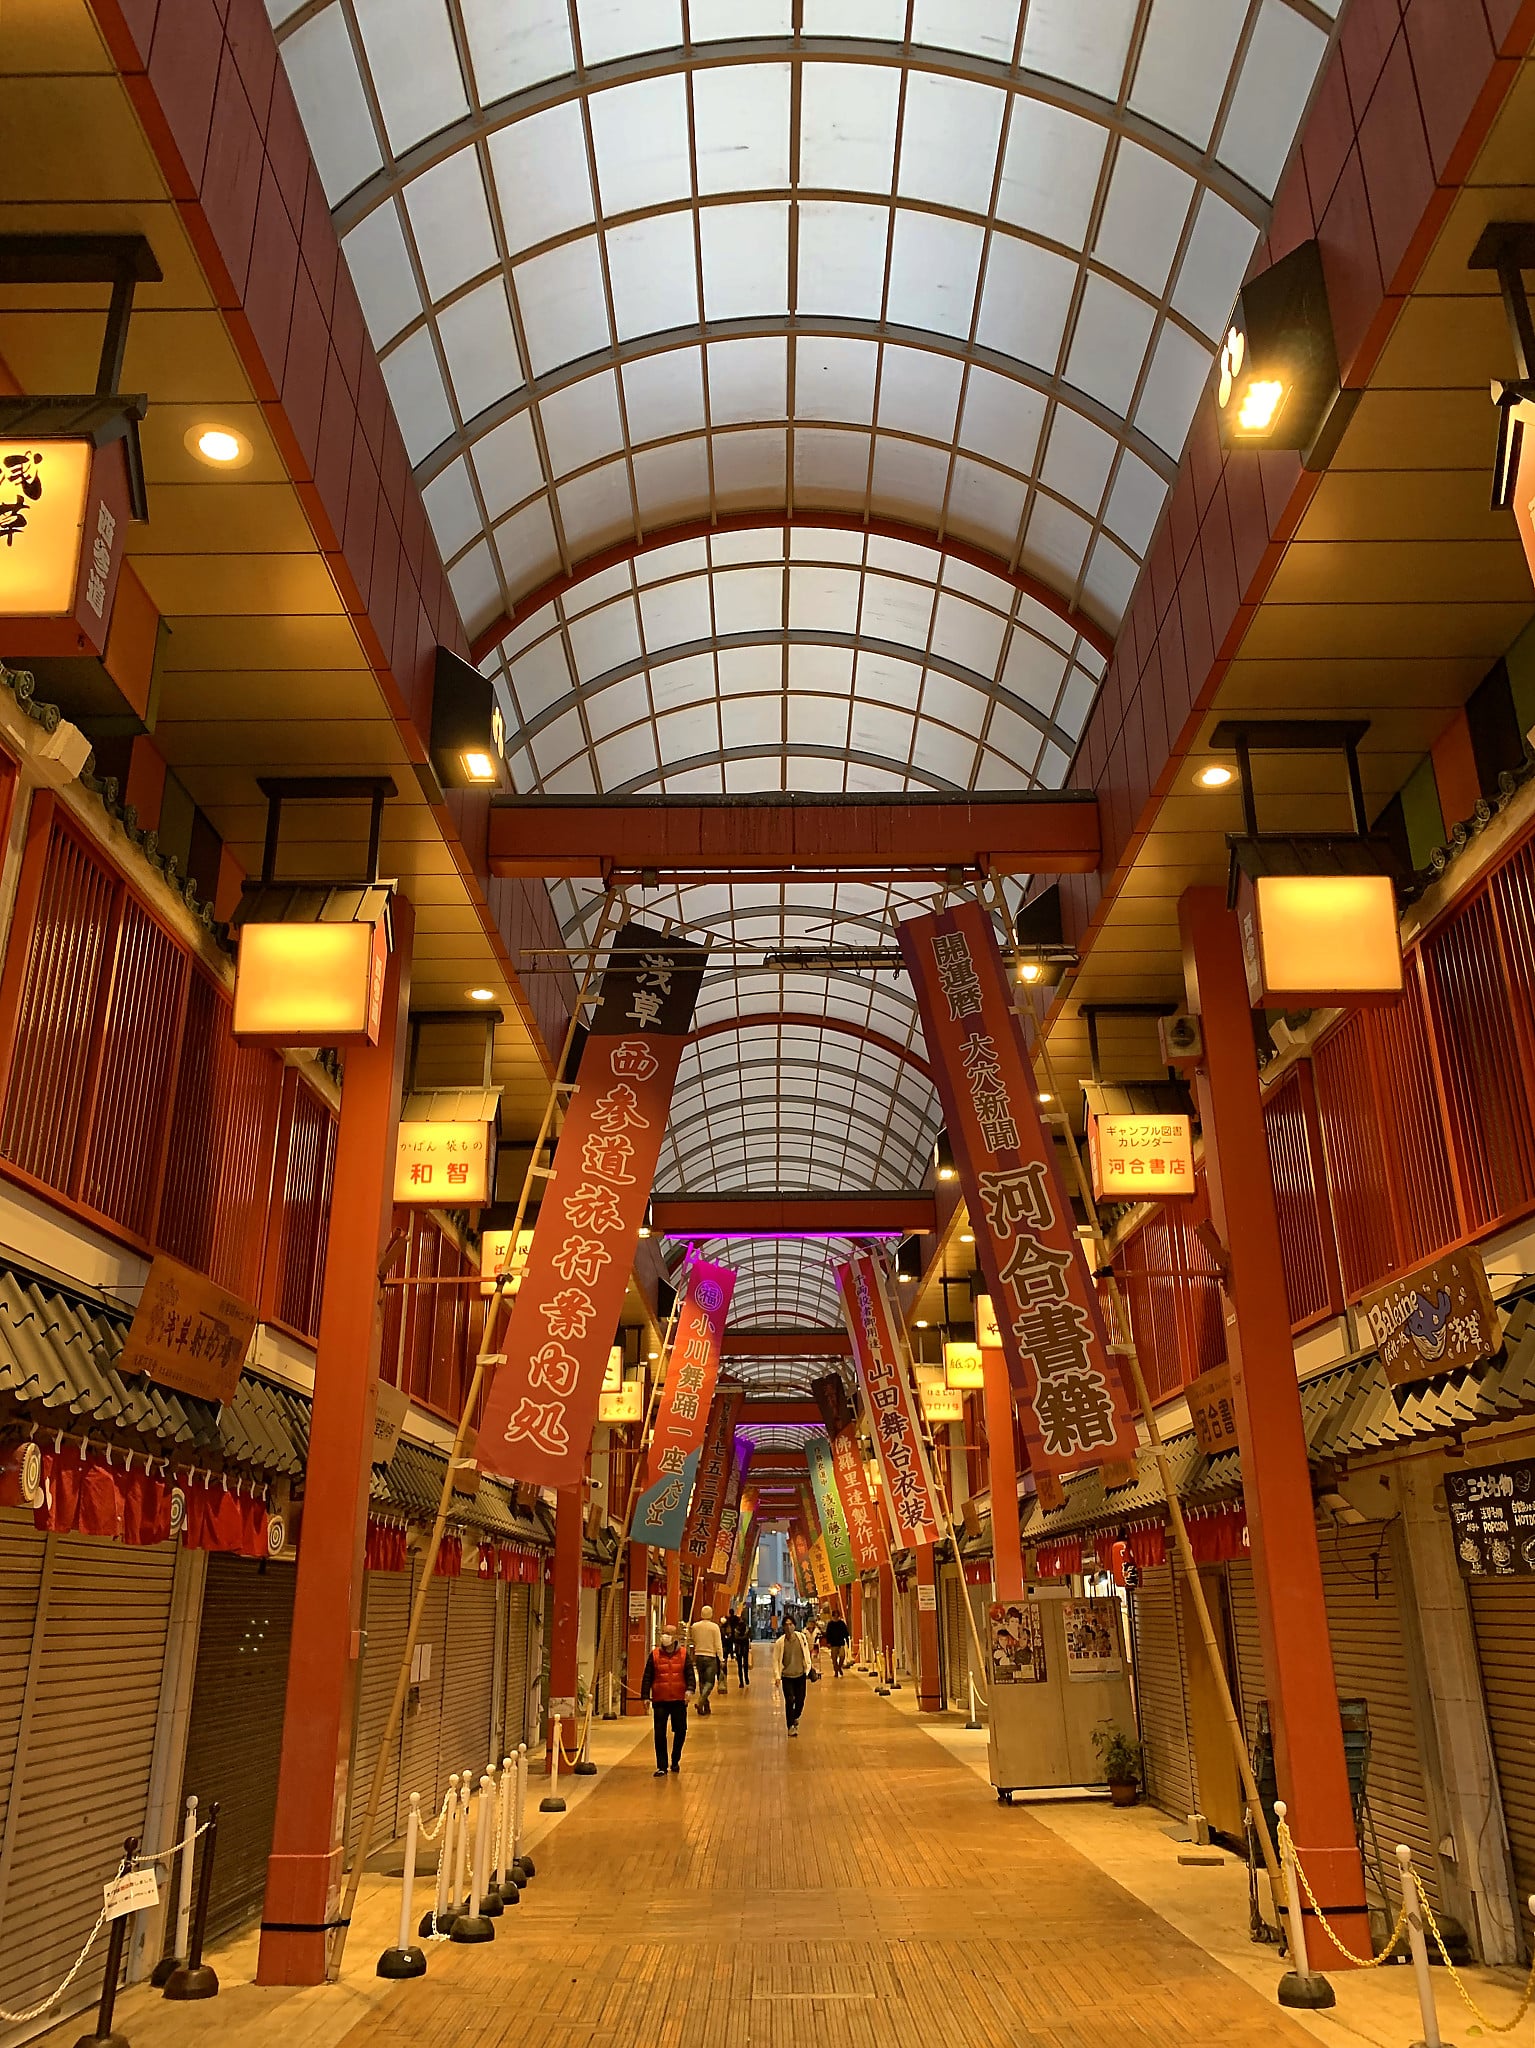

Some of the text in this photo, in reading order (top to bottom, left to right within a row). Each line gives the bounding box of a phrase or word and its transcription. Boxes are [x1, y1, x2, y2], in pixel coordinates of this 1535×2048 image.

[625, 953, 675, 1028] 浅草
[959, 1033, 1021, 1153] 大穴新聞
[400, 1140, 436, 1152] かばん
[1119, 1137, 1173, 1148] カレンダー
[411, 1162, 469, 1185] 和智
[1109, 1158, 1185, 1175] 河合書店
[504, 1041, 659, 1456] 西参道旅行案内処
[1368, 1290, 1419, 1348] Baleine
[868, 1358, 933, 1529] 山田舞台衣装
[688, 1440, 727, 1559] 七五三屋太郎
[1467, 1474, 1513, 1501] 三大名物
[1482, 1520, 1508, 1533] POPCORN
